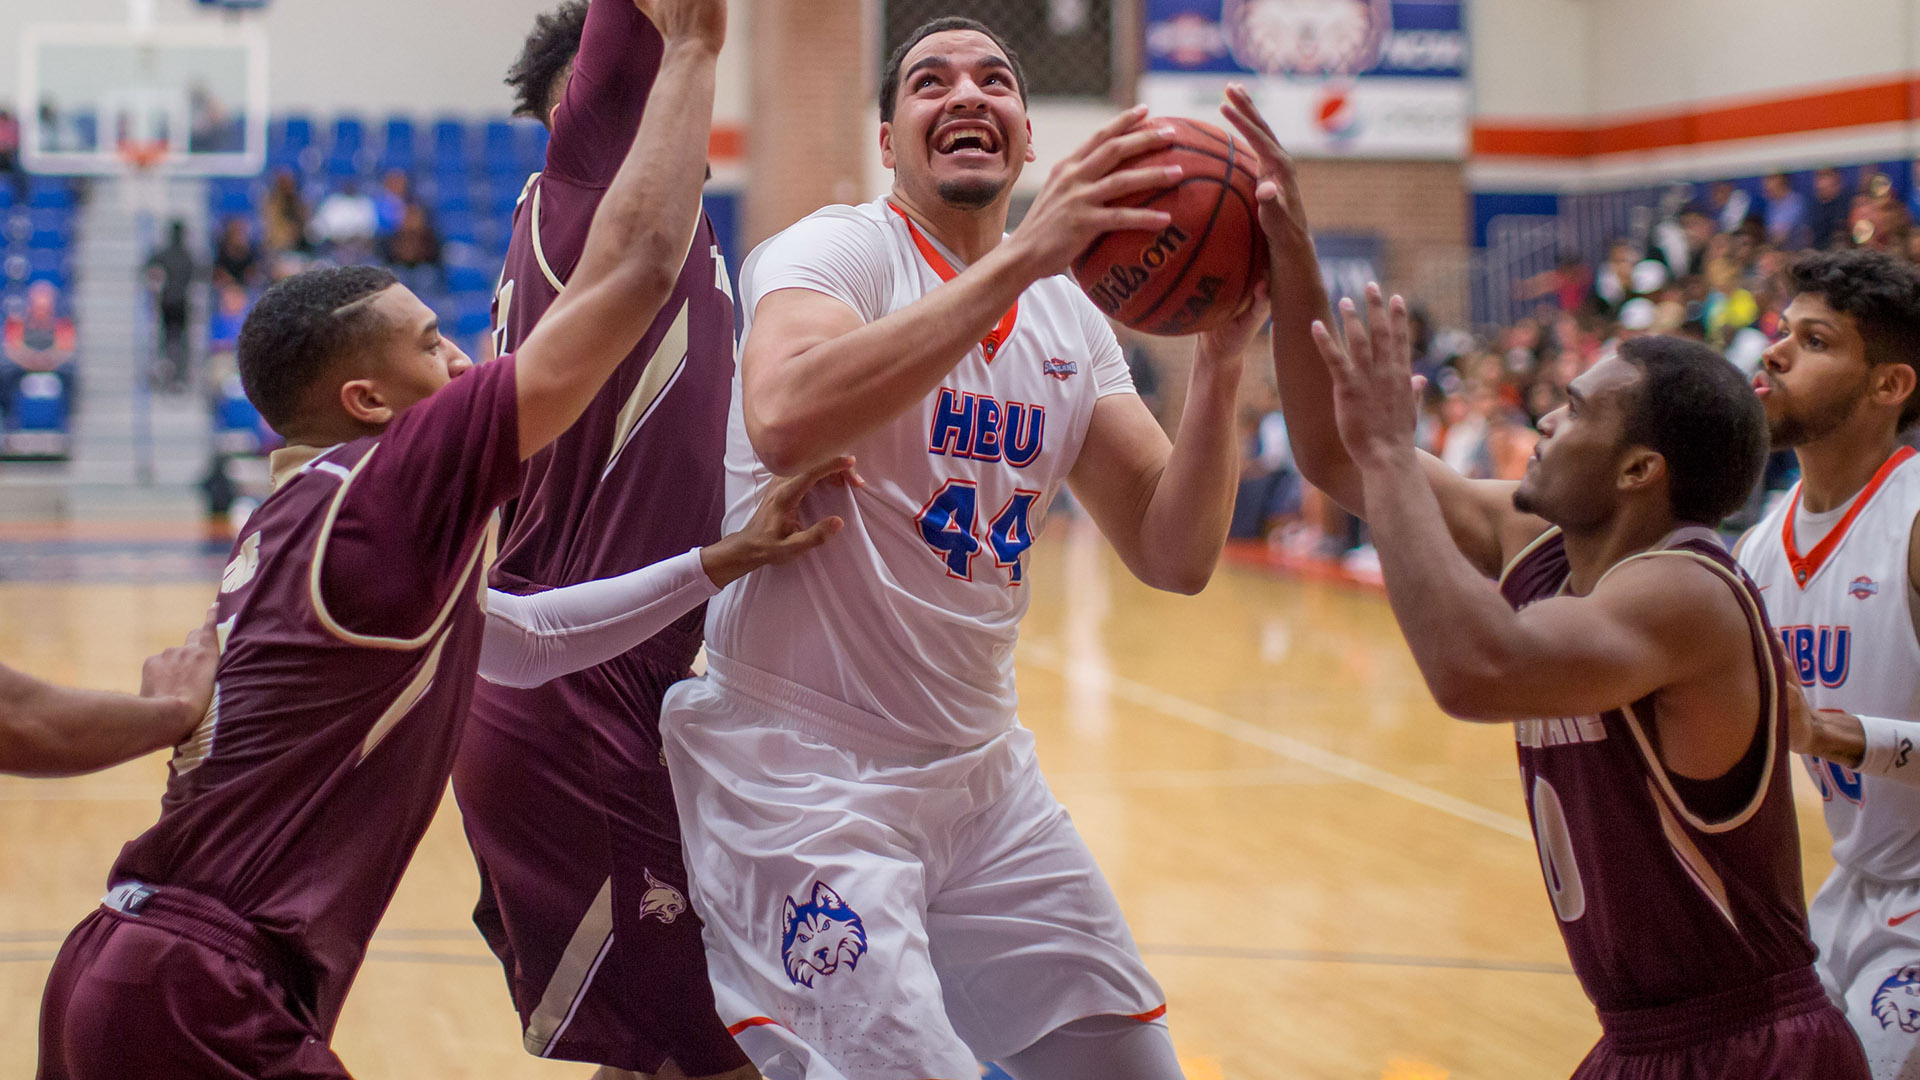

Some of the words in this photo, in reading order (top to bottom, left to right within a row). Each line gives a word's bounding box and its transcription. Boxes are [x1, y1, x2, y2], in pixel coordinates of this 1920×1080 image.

[1088, 224, 1188, 316] Wilson
[929, 387, 1045, 468] HBU
[914, 478, 1041, 587] 44
